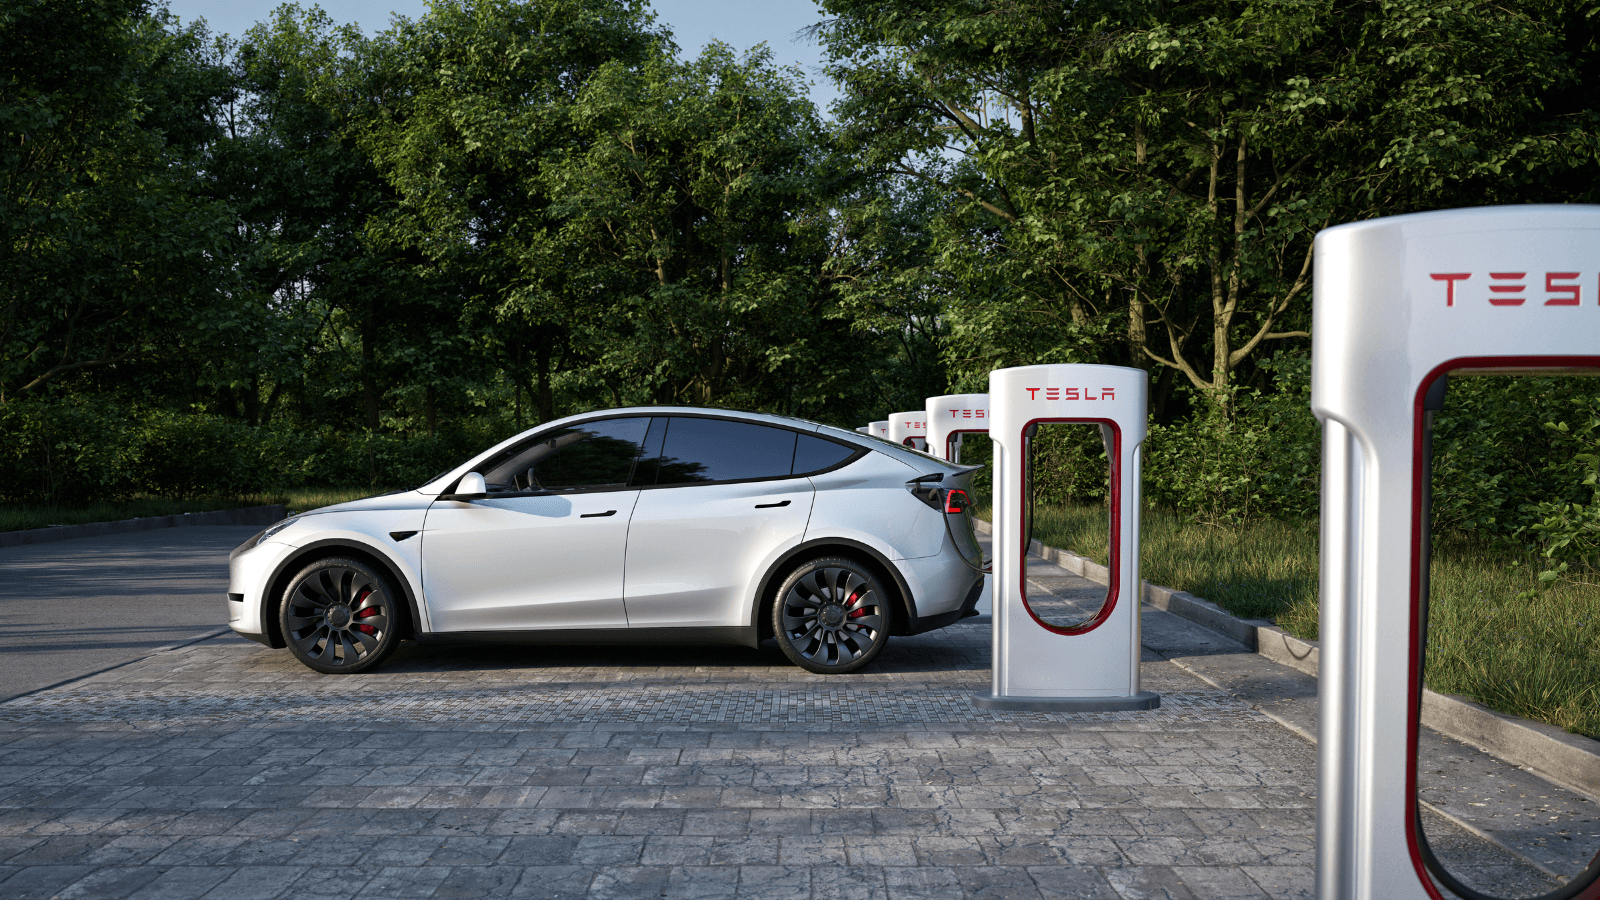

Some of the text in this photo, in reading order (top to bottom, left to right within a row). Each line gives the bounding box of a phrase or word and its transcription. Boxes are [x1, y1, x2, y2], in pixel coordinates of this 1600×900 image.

[1429, 272, 1600, 307] TES
[1025, 387, 1115, 401] TESLA
[949, 409, 989, 418] TES
